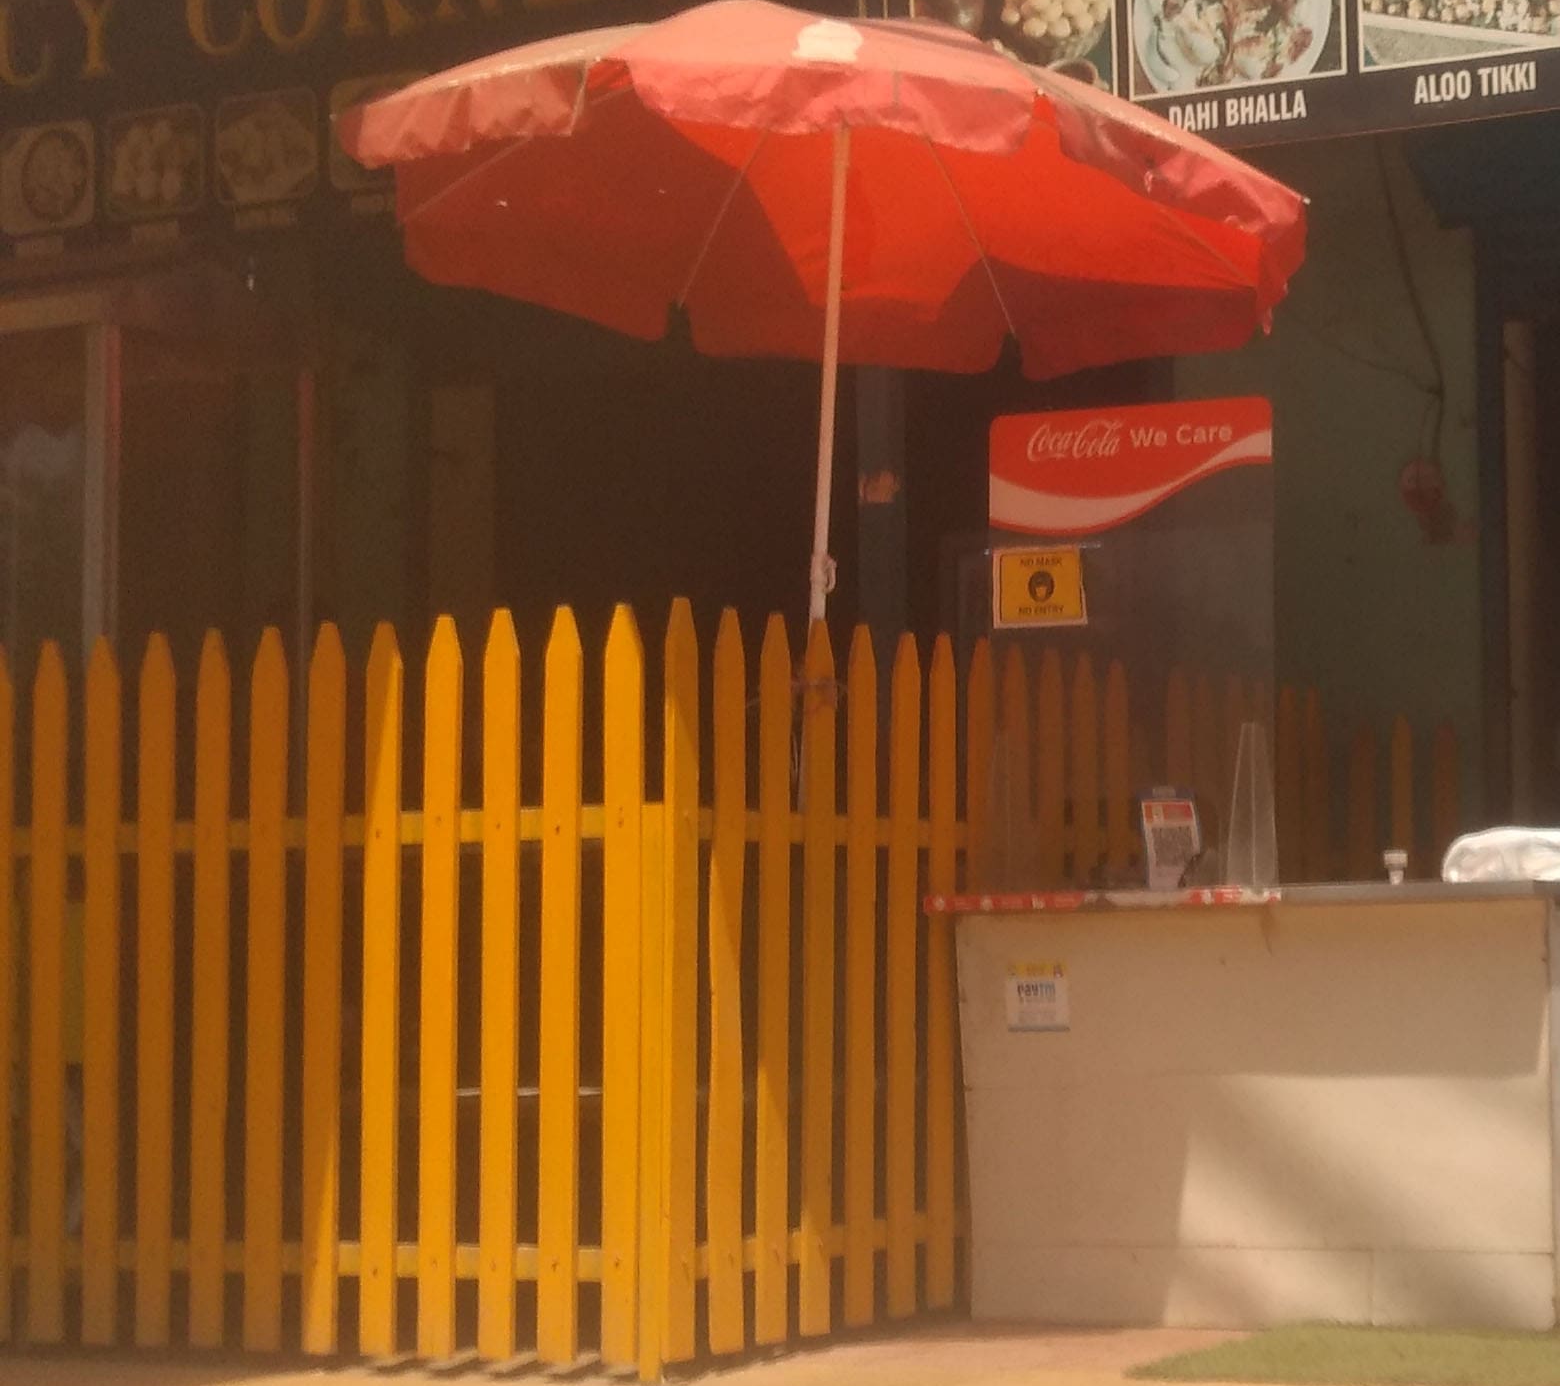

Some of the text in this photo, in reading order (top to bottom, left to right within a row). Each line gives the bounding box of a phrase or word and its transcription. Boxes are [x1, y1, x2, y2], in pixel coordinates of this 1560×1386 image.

[1414, 61, 1537, 105] ALOO TIKKI
[1168, 89, 1307, 132] DAHI BHALLA
[1130, 427, 1168, 448] We
[1176, 424, 1233, 445] Care
[1020, 556, 1063, 567] NO MASK
[1018, 604, 1064, 615] NO ENTRY
